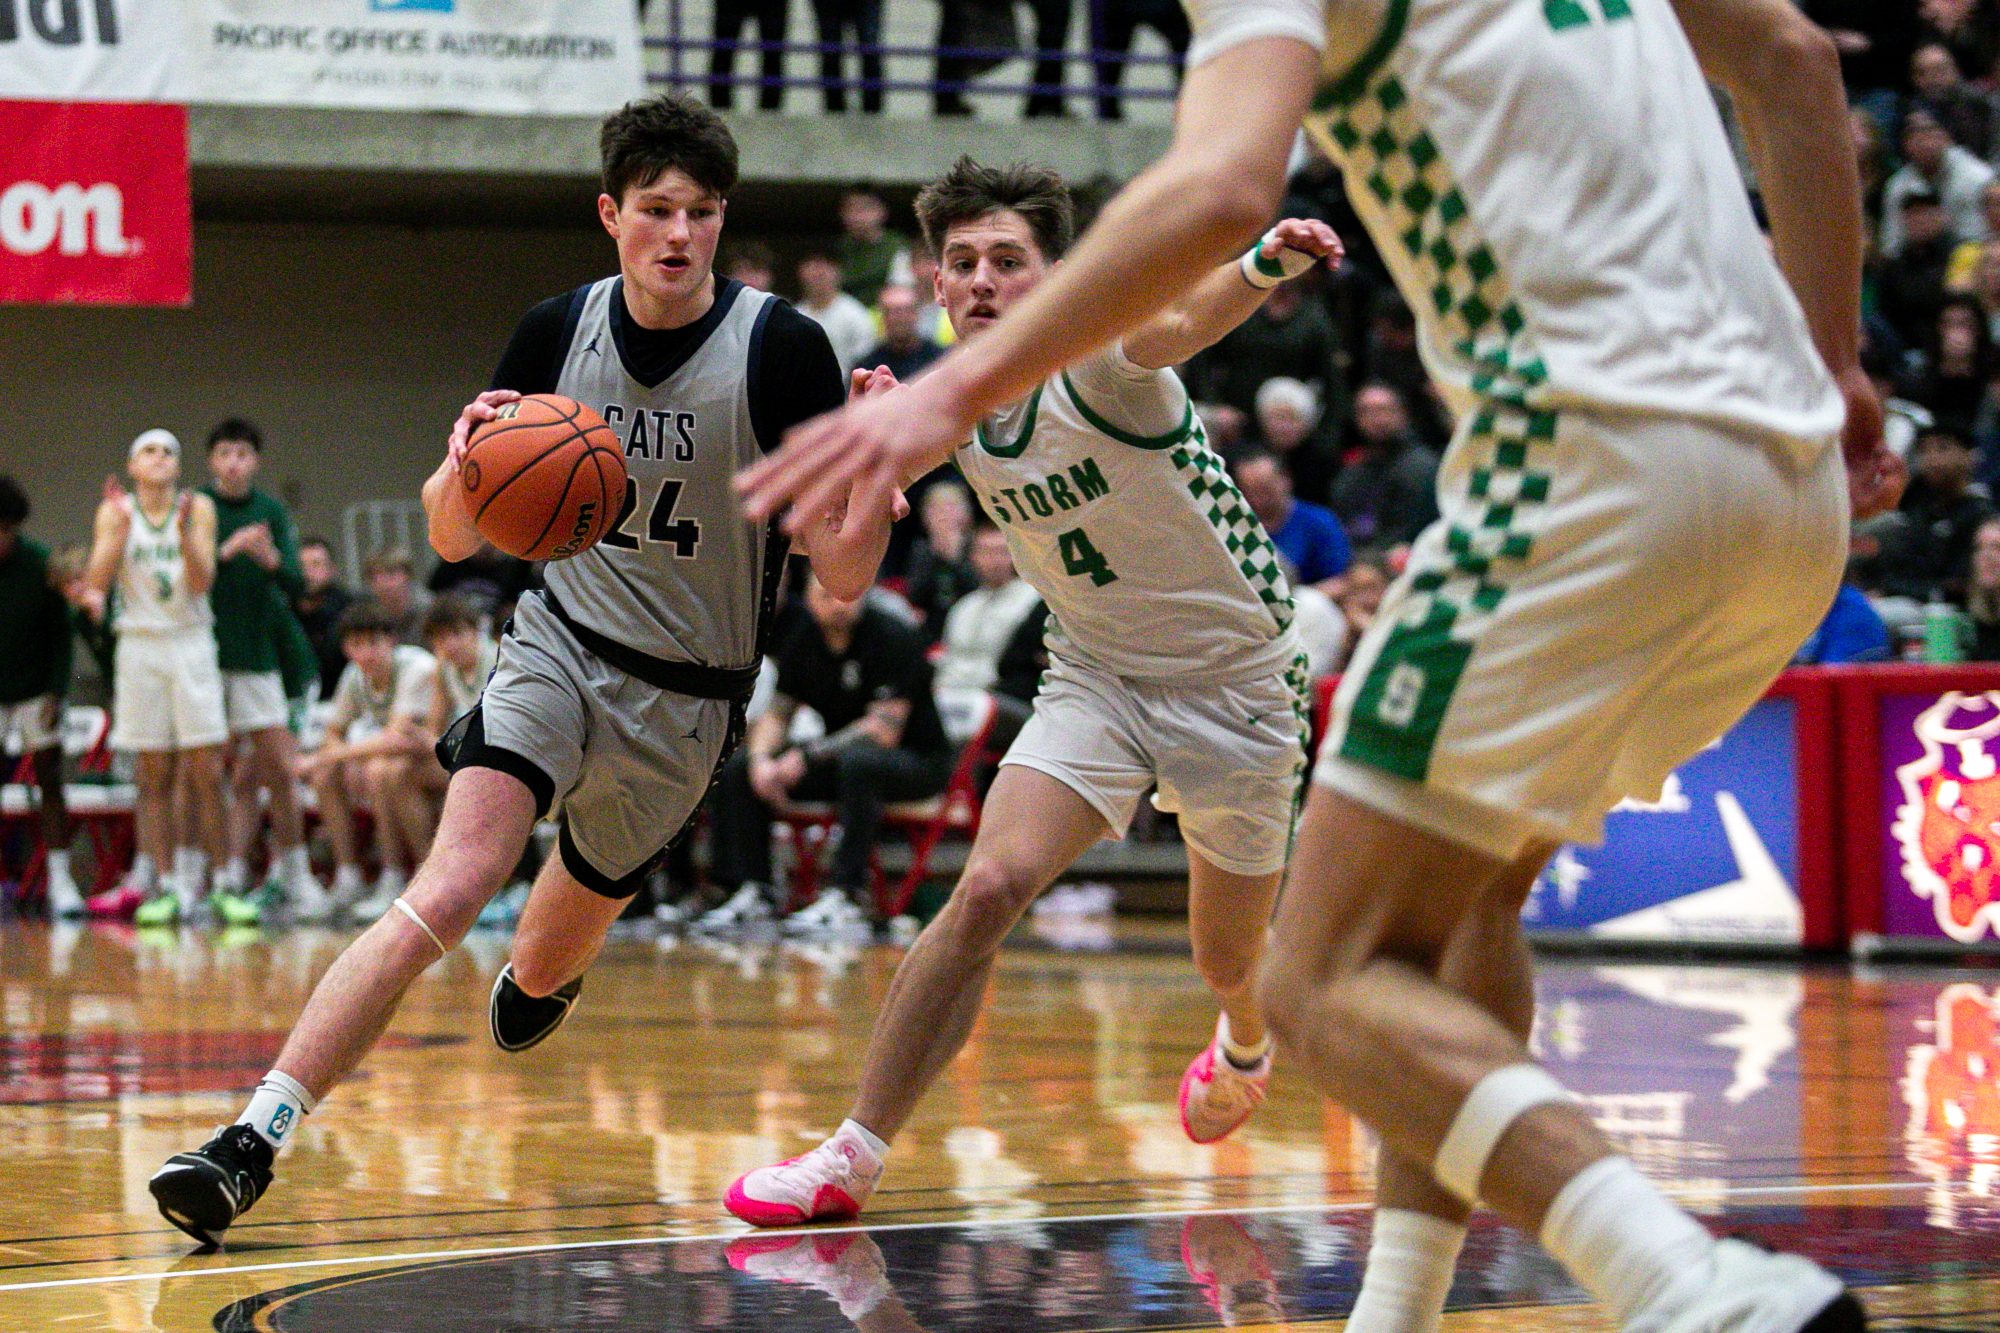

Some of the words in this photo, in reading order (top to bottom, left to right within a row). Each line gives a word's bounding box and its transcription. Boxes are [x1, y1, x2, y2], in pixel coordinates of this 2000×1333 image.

[213, 22, 315, 53] PACIFIC
[325, 26, 428, 55] OFFICE
[436, 31, 617, 59] AUTOMATION
[600, 475, 702, 560] 24
[990, 456, 1111, 524] STORM
[1058, 527, 1119, 588] 4
